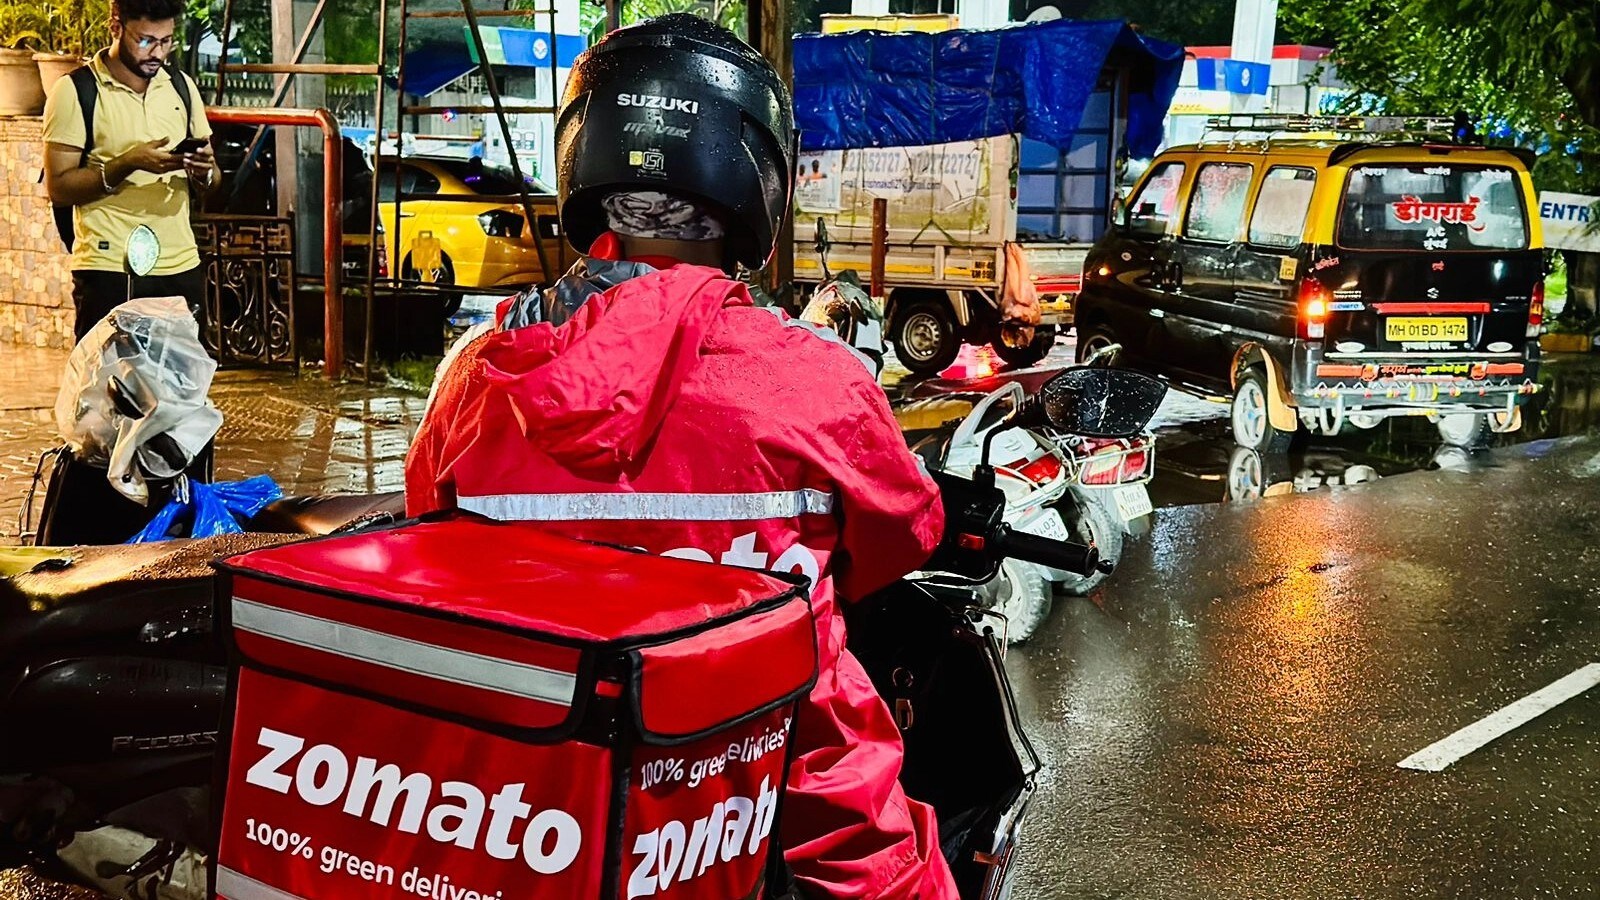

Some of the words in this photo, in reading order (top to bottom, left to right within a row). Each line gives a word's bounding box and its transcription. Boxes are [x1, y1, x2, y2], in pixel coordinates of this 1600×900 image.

[616, 93, 699, 114] SUZUKI
[1388, 325, 1405, 336] MH
[1443, 325, 1465, 336] 1474
[641, 758, 684, 791] 100%
[688, 754, 727, 787] gree
[246, 727, 582, 874] zomato
[246, 818, 313, 859] 100%
[320, 845, 394, 885] green
